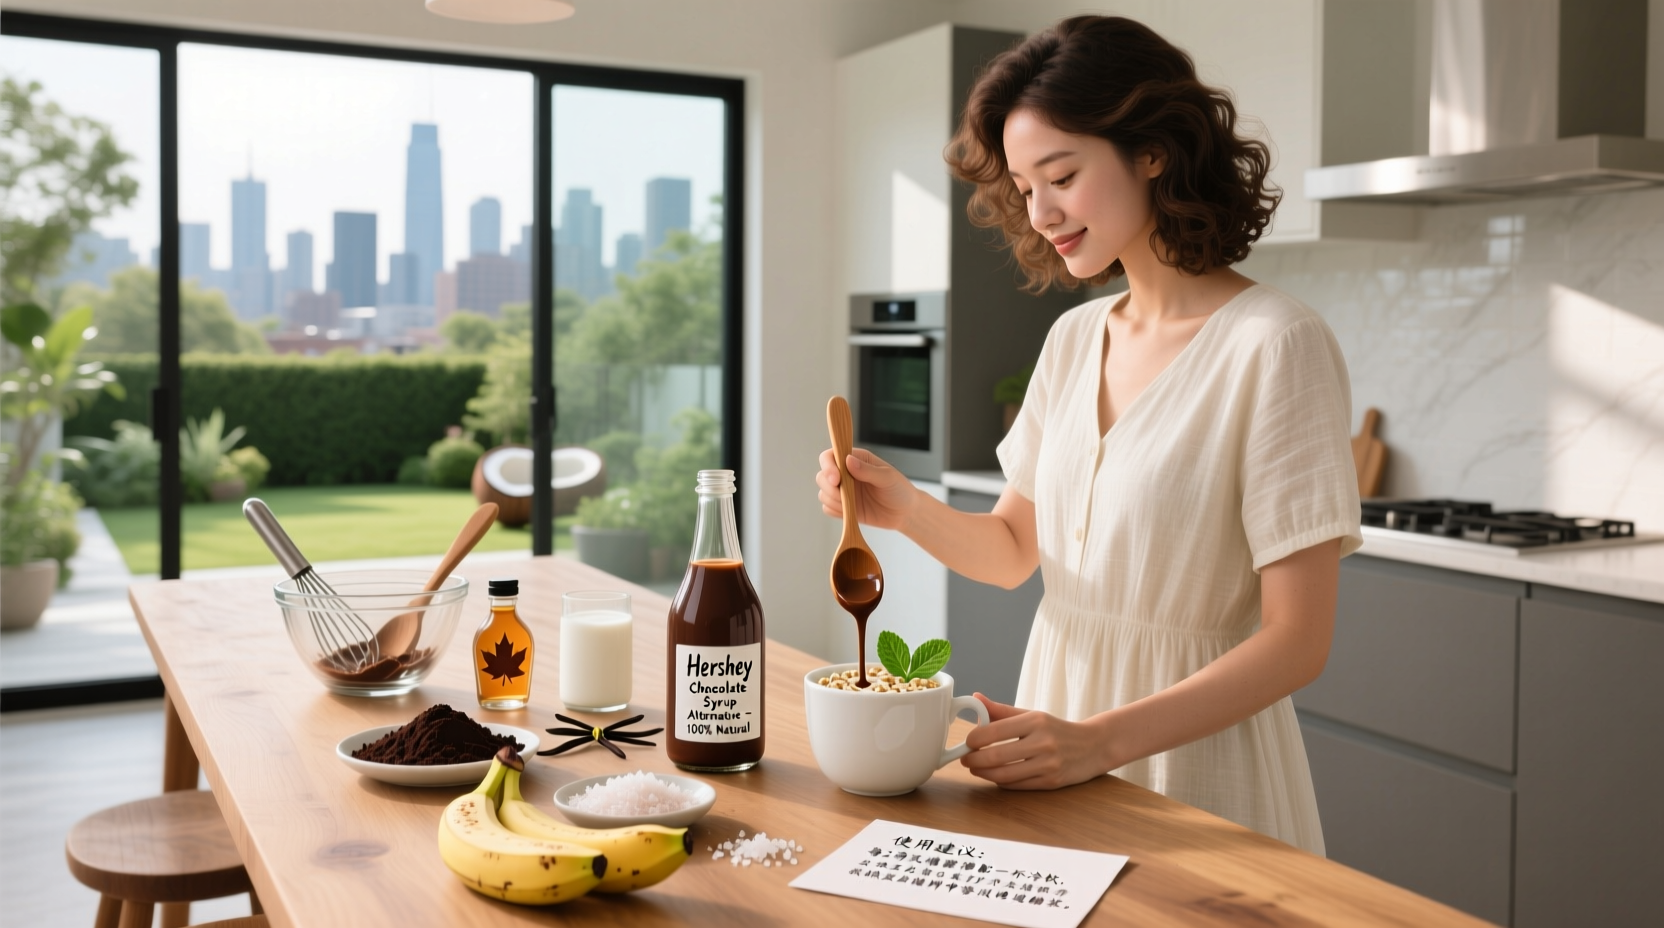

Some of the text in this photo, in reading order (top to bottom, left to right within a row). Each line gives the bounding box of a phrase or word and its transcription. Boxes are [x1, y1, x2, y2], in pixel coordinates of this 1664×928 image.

[687, 653, 753, 682] Hershey
[703, 695, 737, 711] Syrup
[687, 721, 750, 735] 100% Natural
